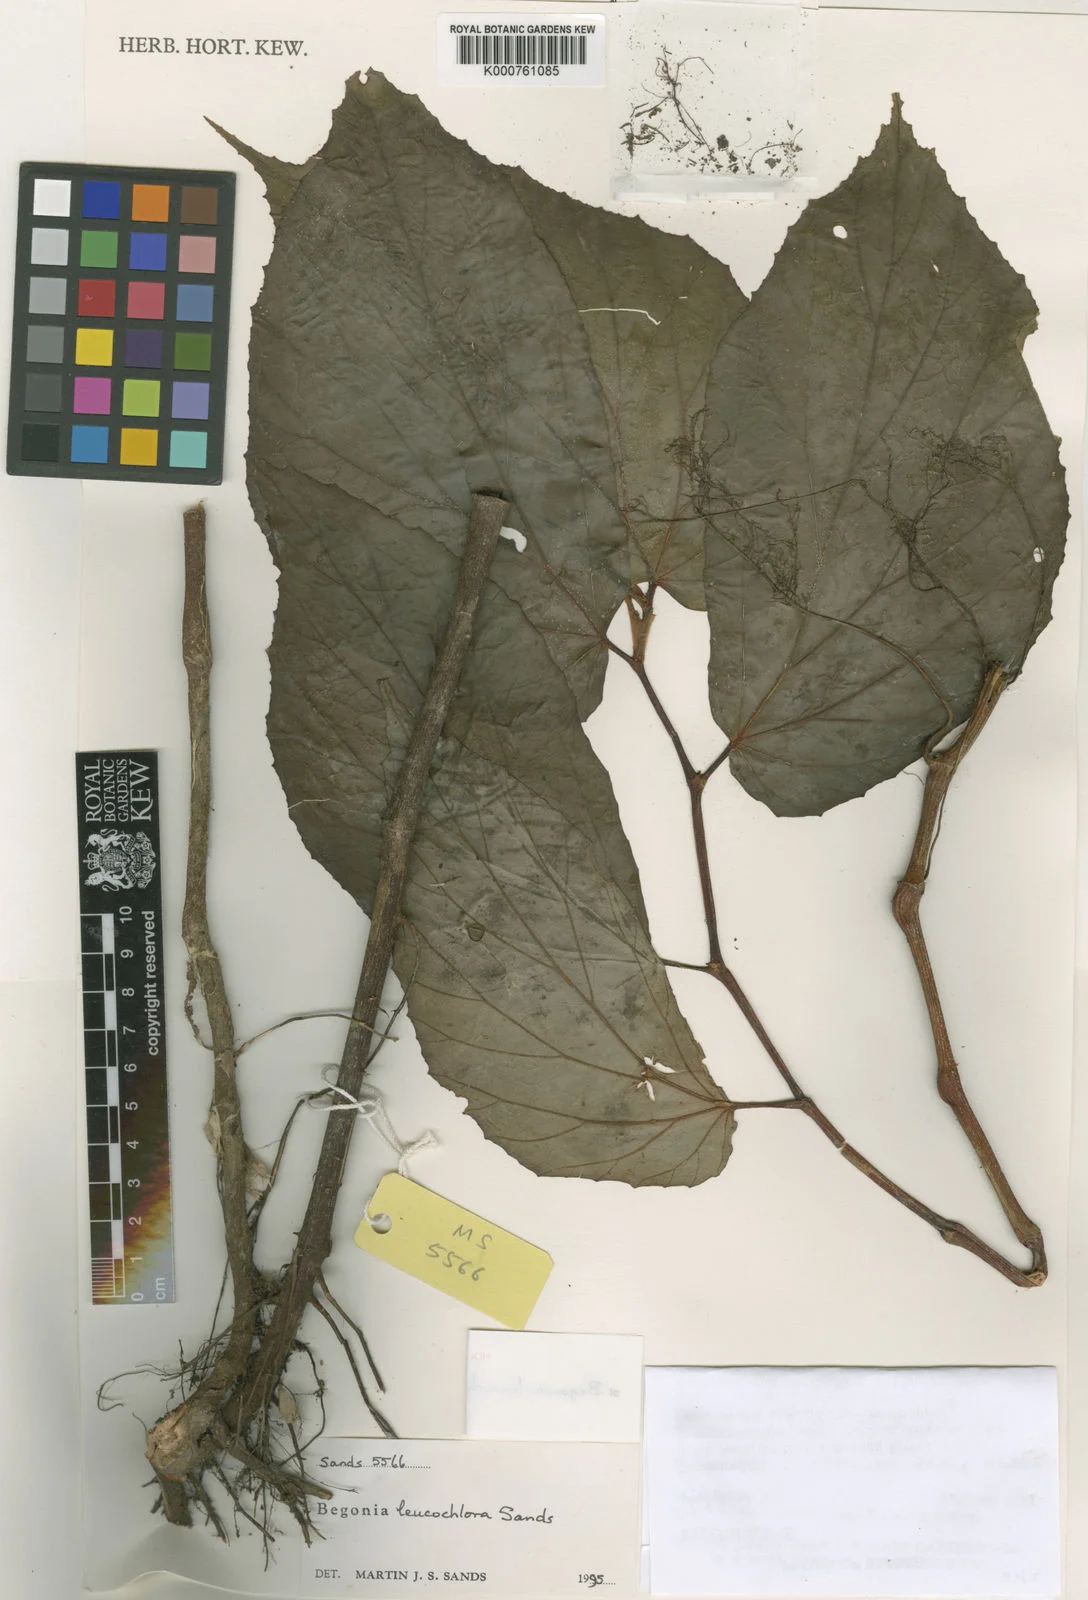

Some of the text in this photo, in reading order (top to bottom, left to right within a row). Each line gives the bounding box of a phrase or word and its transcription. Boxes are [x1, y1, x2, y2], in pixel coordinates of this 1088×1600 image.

[450, 25, 596, 34] ROYAL BOTANIC GARDENS KEW
[119, 36, 308, 57] HERB. HORT. KEW.
[484, 65, 560, 76] K000761085
[84, 759, 103, 823] ROYAL
[103, 759, 116, 822] BOTANIC
[116, 758, 129, 822] GARDENS
[129, 758, 153, 822] KEW
[119, 906, 133, 923] 10
[121, 949, 134, 959] 9
[141, 910, 160, 1056] copyright reserved
[122, 987, 135, 997] 8
[123, 1026, 136, 1035] 7
[124, 1063, 137, 1072] 6
[125, 1101, 139, 1110] 5
[126, 1140, 139, 1149] 4
[127, 1178, 141, 1188] 3
[129, 1216, 142, 1225] 2
[425, 1243, 486, 1281] 5566
[155, 1277, 166, 1301] cm
[319, 1454, 406, 1468] Sands 5566
[317, 1499, 554, 1524] Begonia leucochlora Sands
[314, 1568, 487, 1582] DET. MARTIN J. S. SANDS
